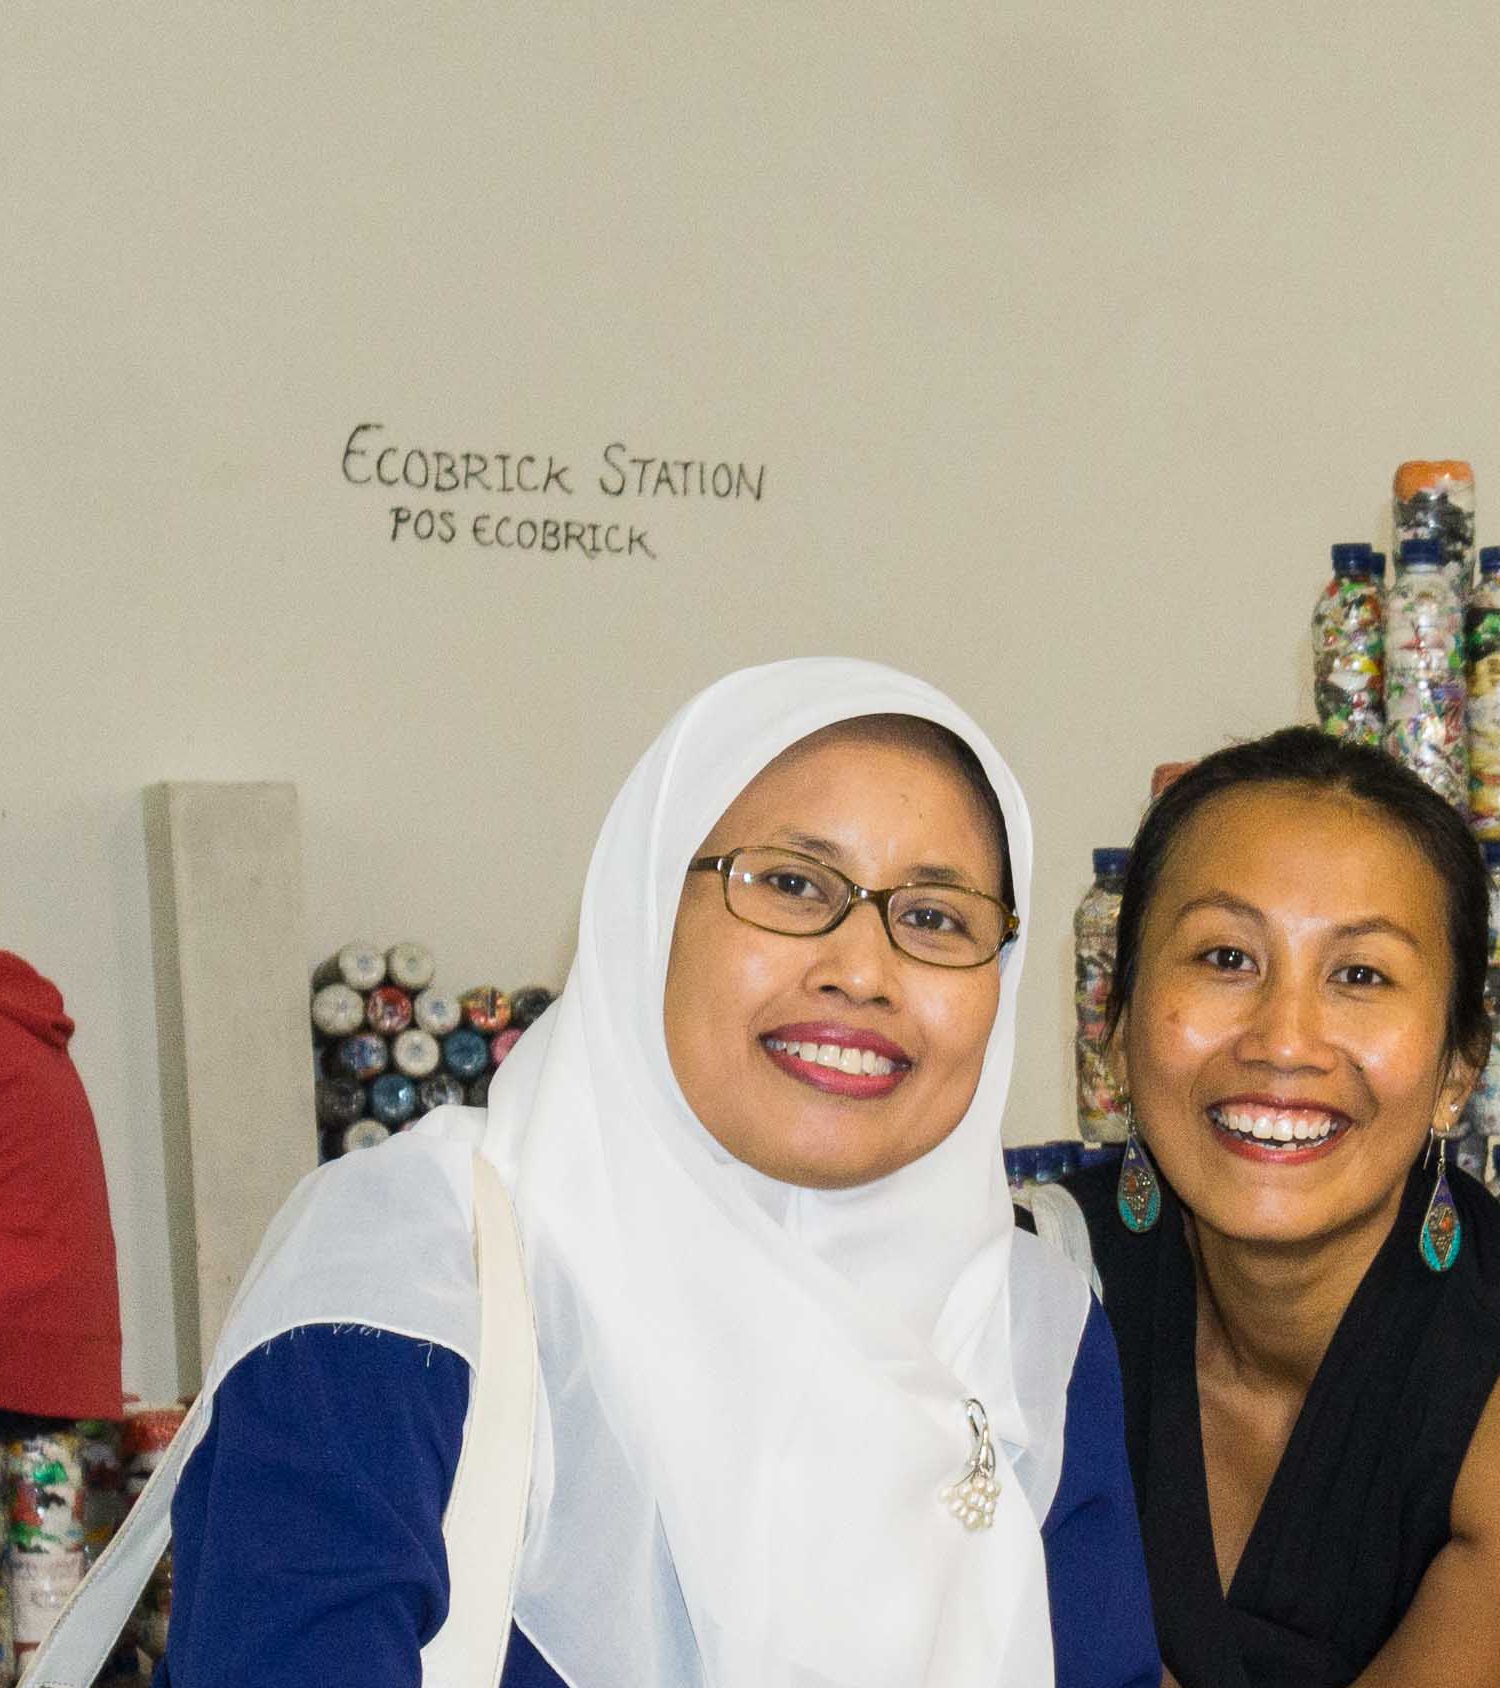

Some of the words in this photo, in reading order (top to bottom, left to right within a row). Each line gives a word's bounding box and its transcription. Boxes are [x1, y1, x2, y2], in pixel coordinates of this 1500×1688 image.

[341, 422, 574, 495] ECOBRICK
[598, 443, 767, 502] STATION
[389, 506, 457, 545] POS
[471, 513, 657, 560] ECOBRICK
